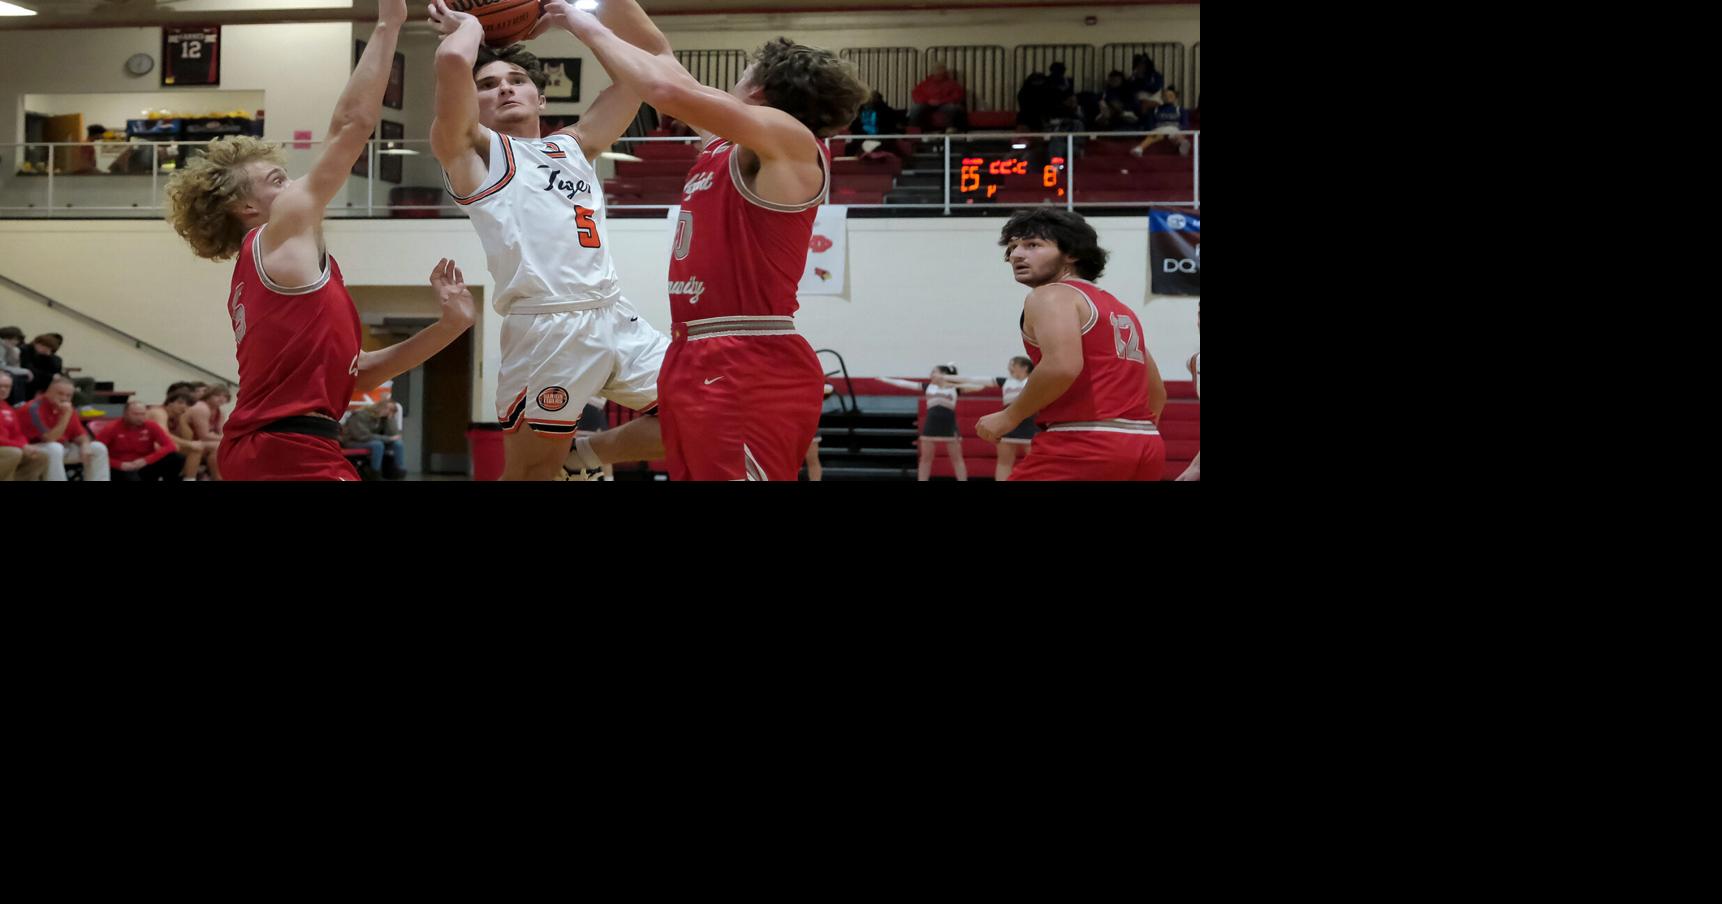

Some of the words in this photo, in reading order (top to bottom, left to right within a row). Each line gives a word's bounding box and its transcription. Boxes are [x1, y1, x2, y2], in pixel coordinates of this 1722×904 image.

[181, 40, 202, 59] 12
[574, 204, 601, 249] 5
[1162, 258, 1197, 274] DQ
[1109, 311, 1145, 365] 12
